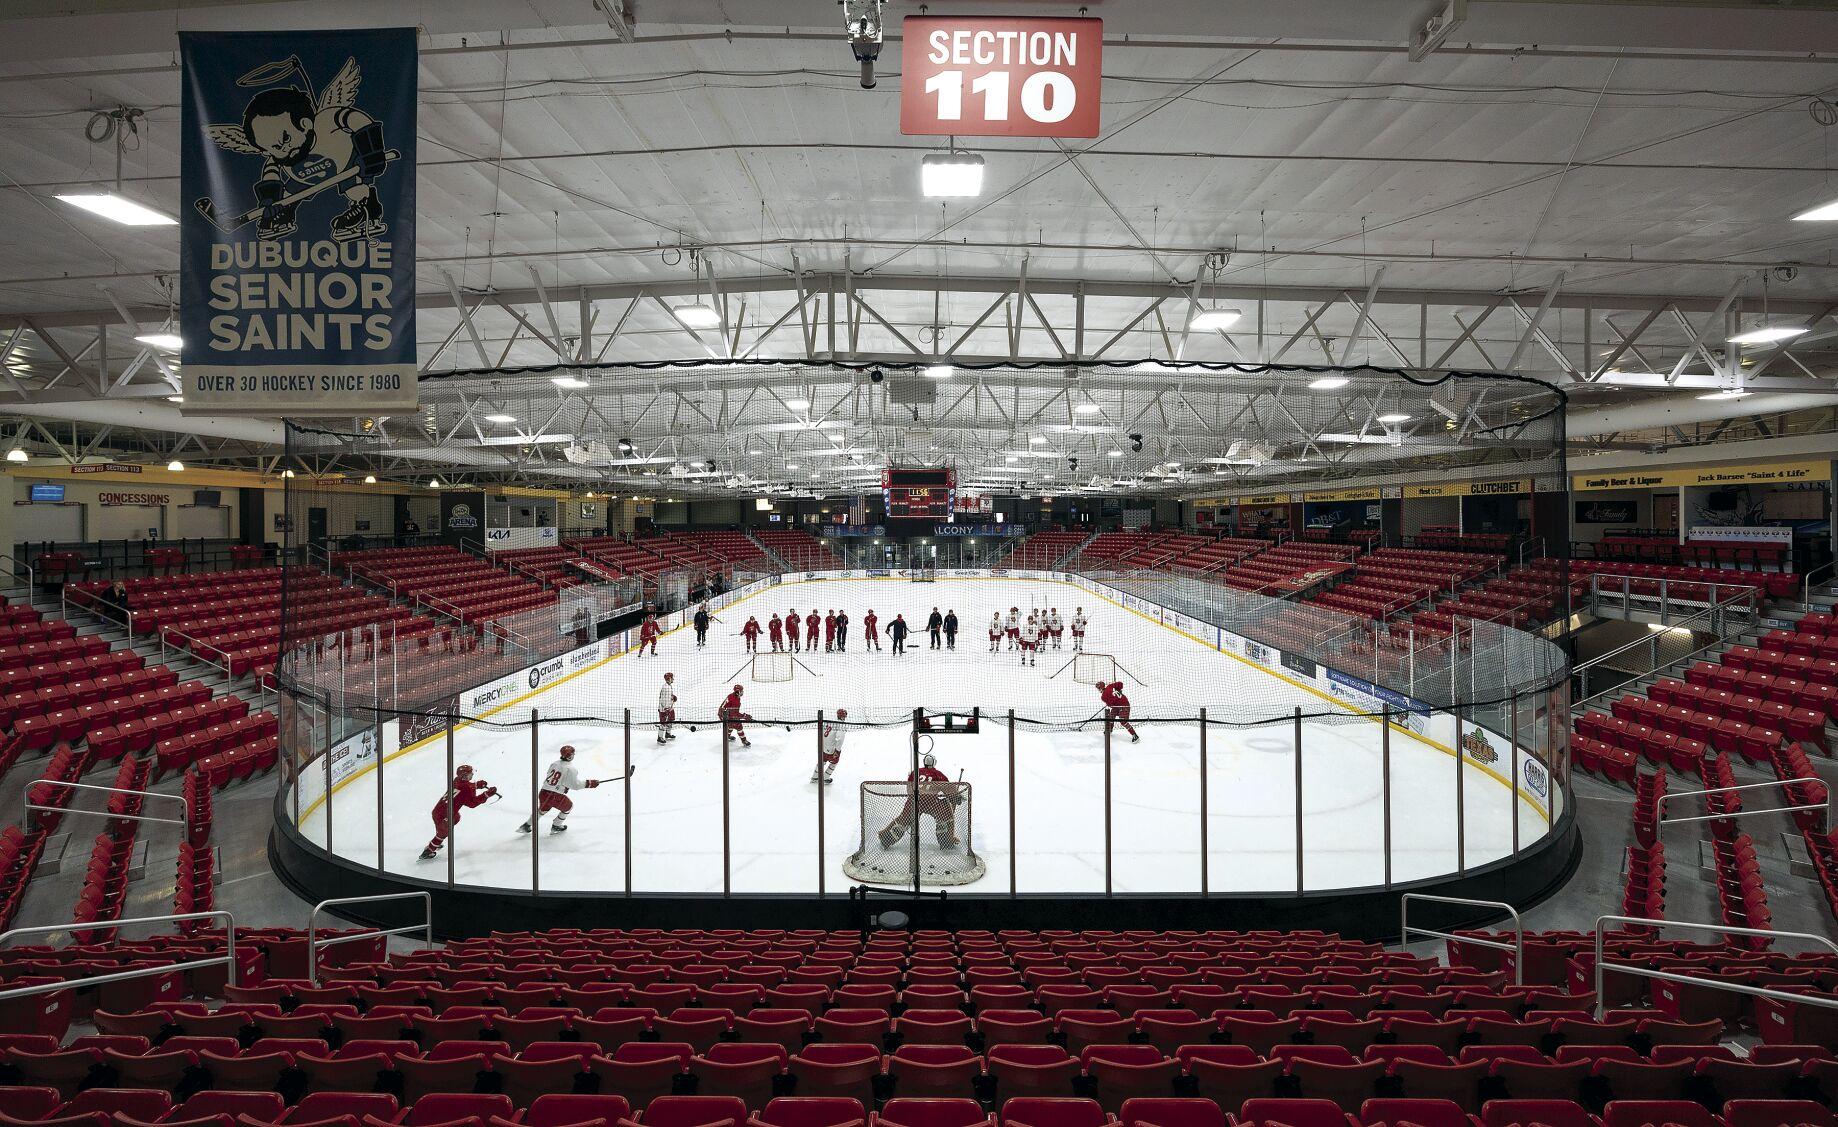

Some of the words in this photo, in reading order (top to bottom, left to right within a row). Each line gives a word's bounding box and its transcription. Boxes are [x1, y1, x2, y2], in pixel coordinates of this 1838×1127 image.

[928, 30, 1077, 66] SECTION
[925, 70, 1077, 123] 110
[211, 240, 392, 270] DUBUQUE
[208, 272, 393, 310] SENIOR
[208, 314, 393, 351] SAINTS
[198, 375, 235, 392] OVER
[240, 375, 257, 391] 30
[262, 374, 315, 391] HOCKEY
[321, 375, 364, 391] SINCE
[369, 374, 400, 391] 1980
[106, 464, 129, 472] SECTION
[1470, 481, 1520, 494] CLUTCHBET
[1586, 479, 1609, 487] Family
[1611, 478, 1628, 486] Beer
[1637, 476, 1663, 486] Liquor
[1787, 482, 1826, 491] SAIN
[98, 492, 170, 504] CONCESSIONS
[450, 518, 476, 526] ARENA
[545, 768, 562, 786] 28
